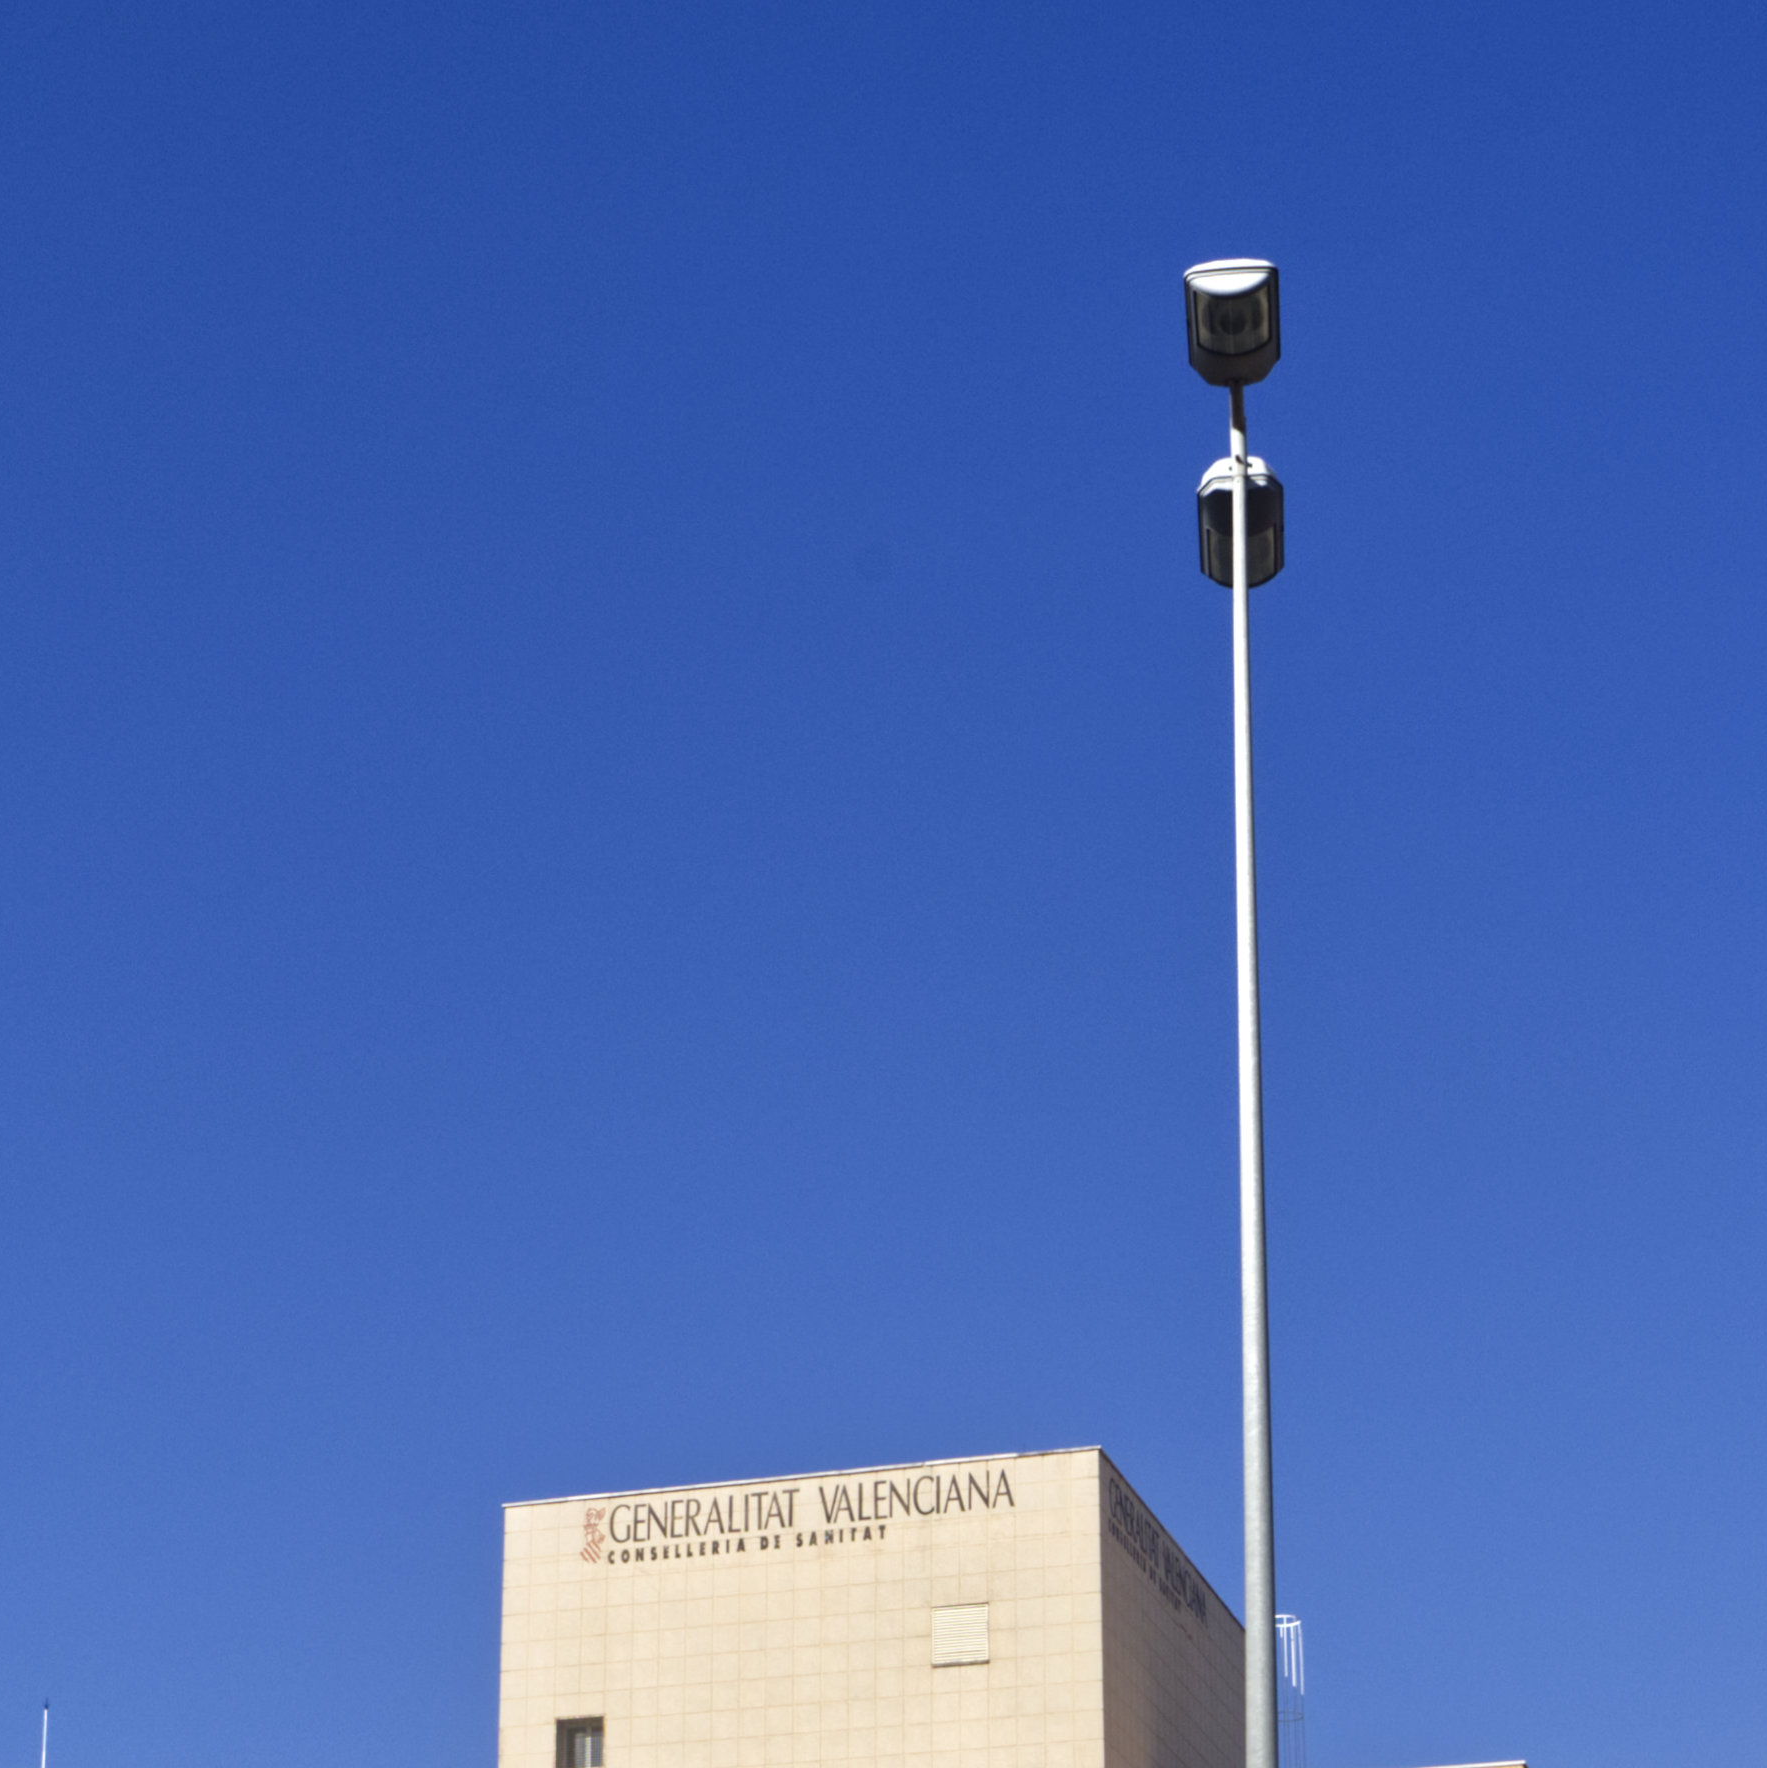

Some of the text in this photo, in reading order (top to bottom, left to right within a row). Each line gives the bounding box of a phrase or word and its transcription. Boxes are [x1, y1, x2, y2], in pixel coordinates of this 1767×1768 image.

[609, 1469, 1015, 1543] GENERALITAT VALENCIANA
[608, 1524, 887, 1564] CONSELLERIA DE SANITAT
